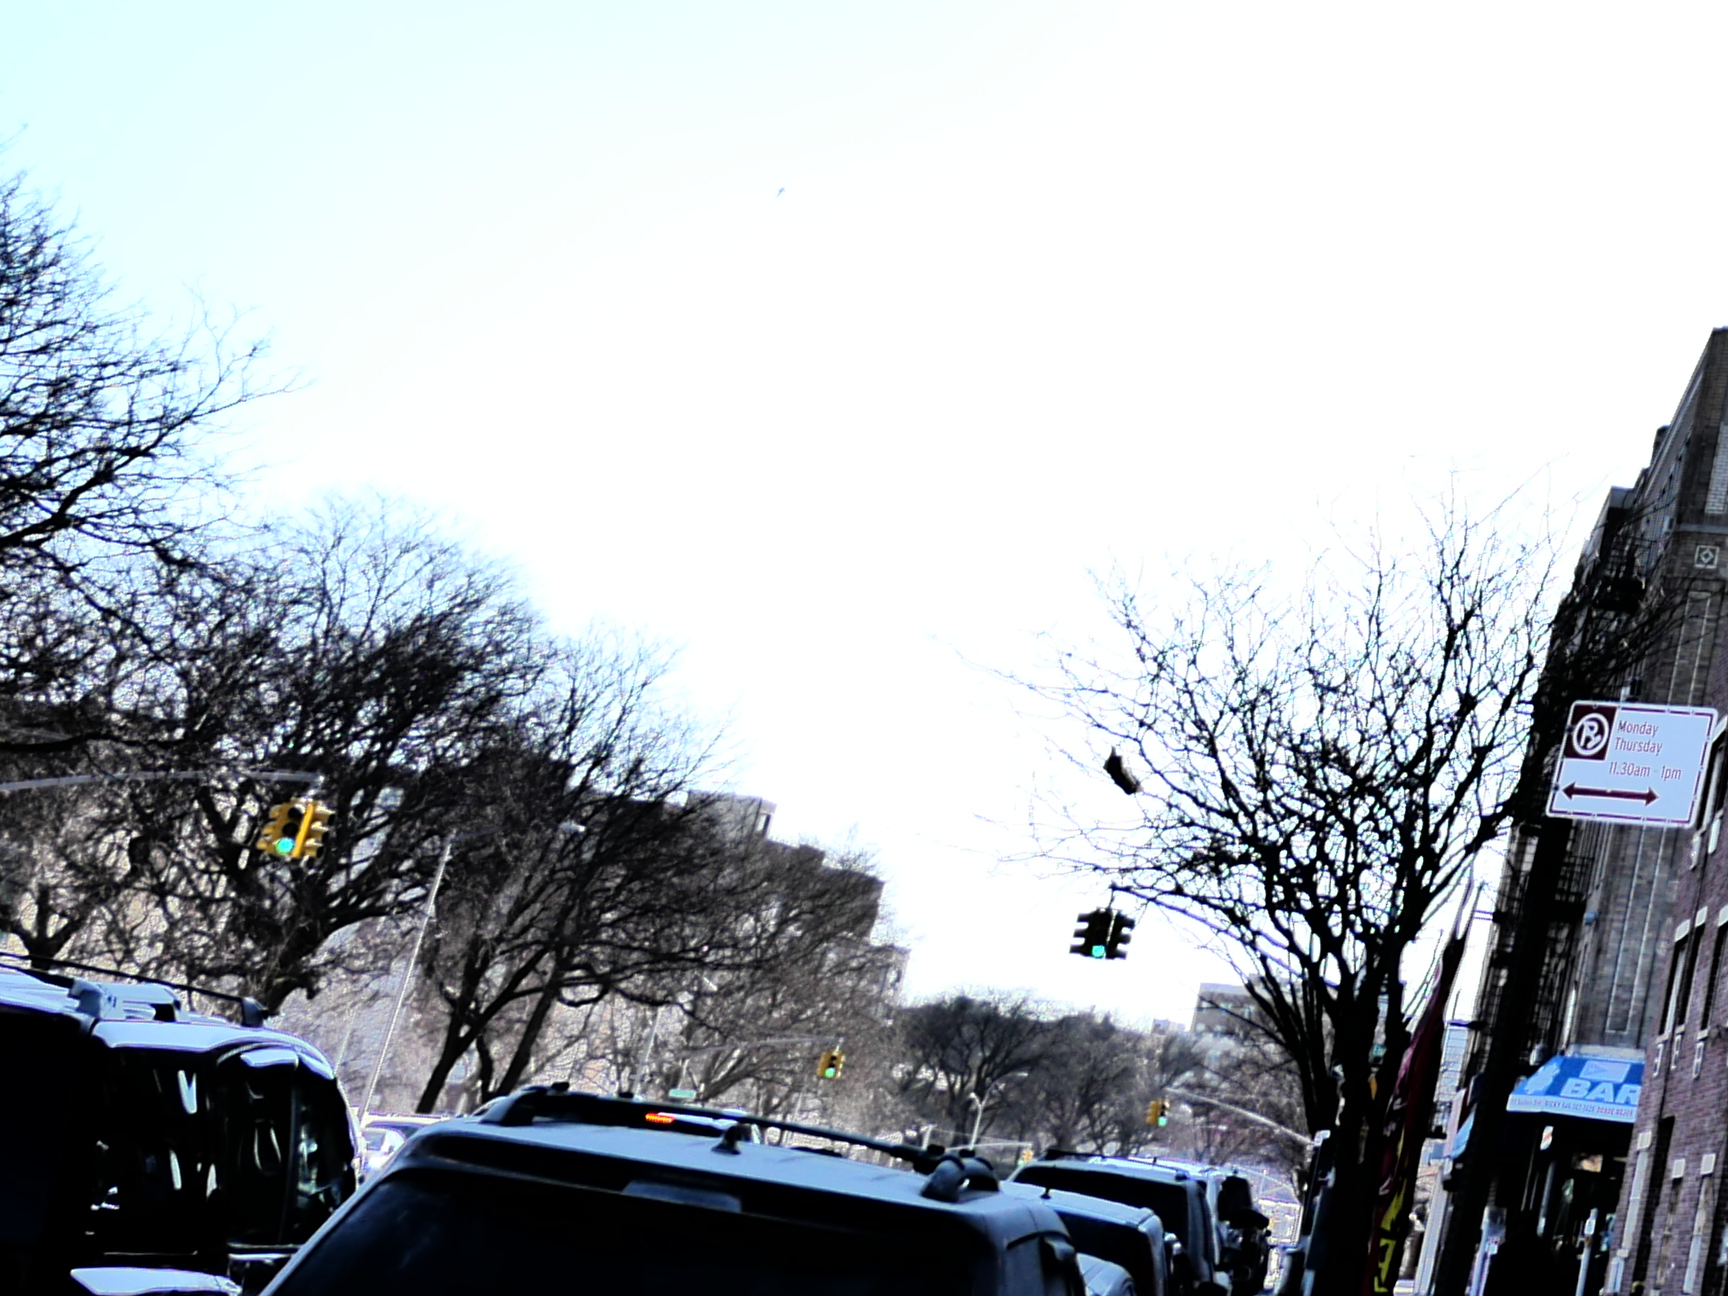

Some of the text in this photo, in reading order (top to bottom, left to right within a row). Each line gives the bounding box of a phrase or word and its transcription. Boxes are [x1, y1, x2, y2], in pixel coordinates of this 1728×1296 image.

[1617, 719, 1660, 739] Monday
[1614, 736, 1663, 756] Thursday
[1660, 765, 1682, 782] 1pm
